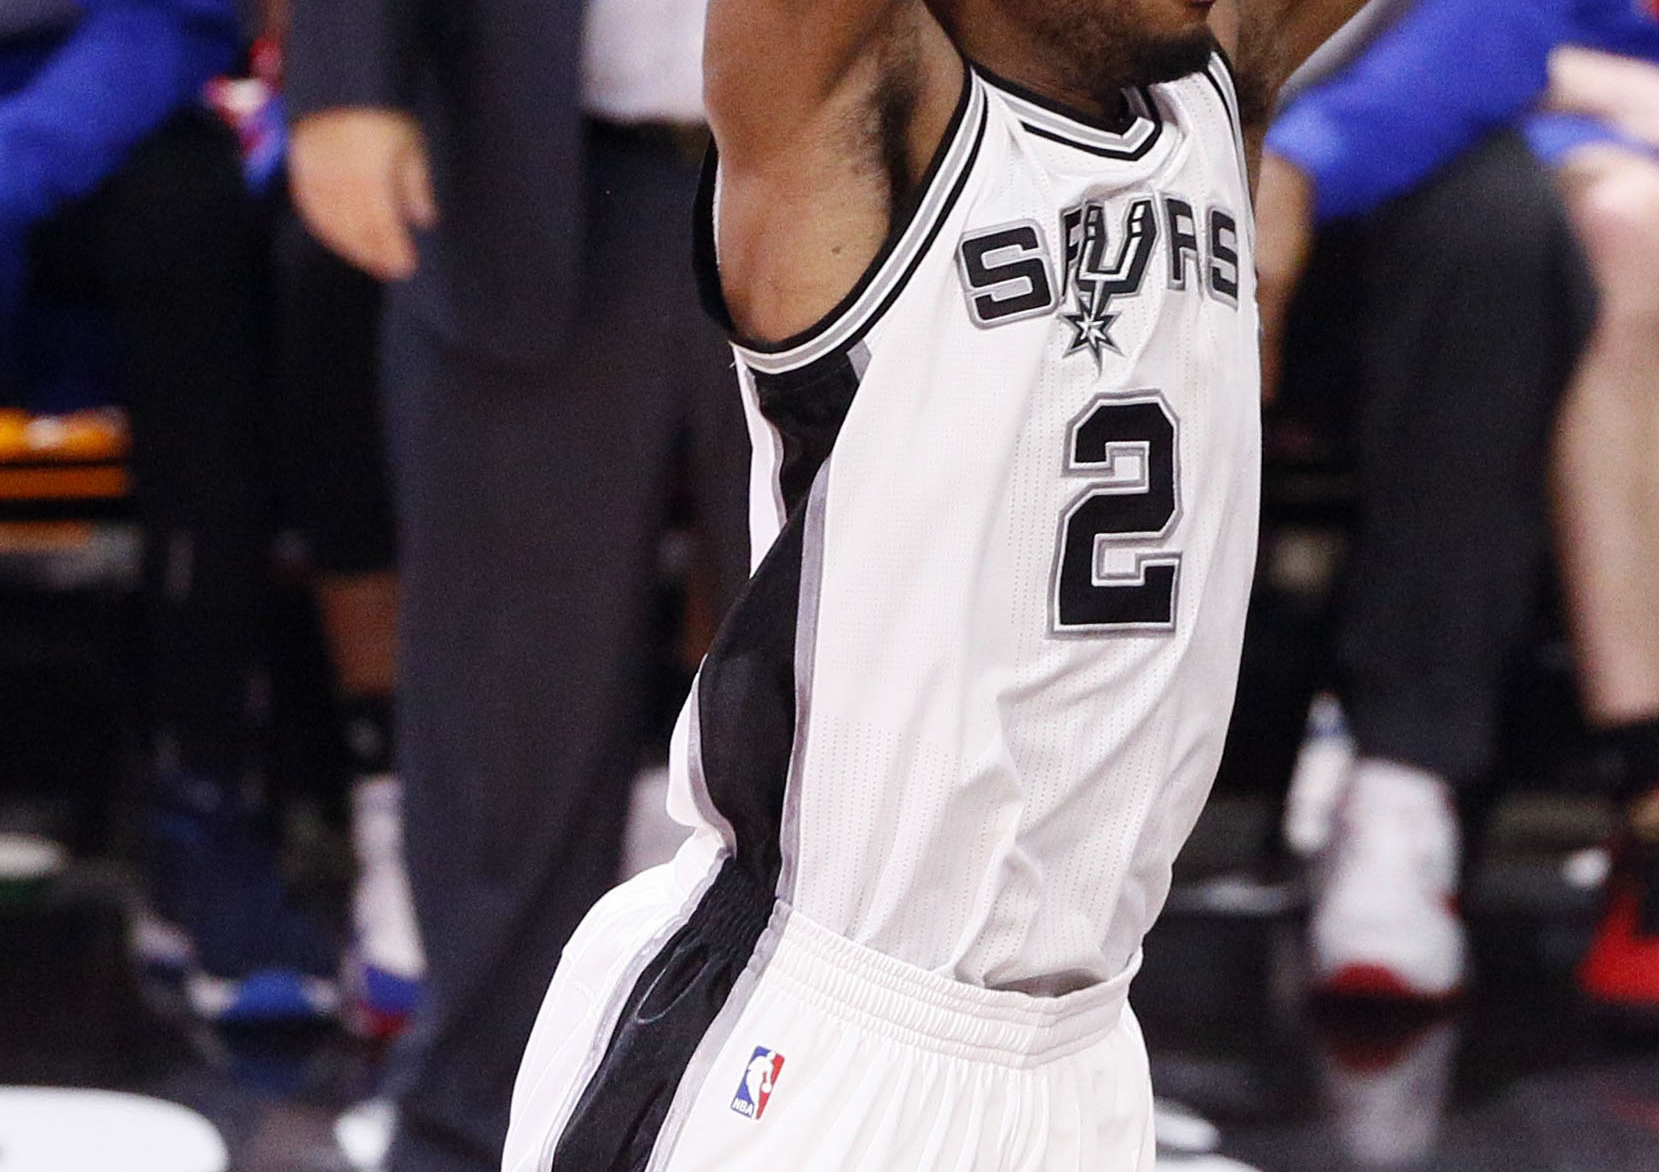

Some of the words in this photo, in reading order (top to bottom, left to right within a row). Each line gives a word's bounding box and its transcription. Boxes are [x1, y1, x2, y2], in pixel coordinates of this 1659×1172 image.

[956, 191, 1239, 343] SPURS
[1046, 388, 1183, 639] 2
[732, 1096, 754, 1118] NBA
